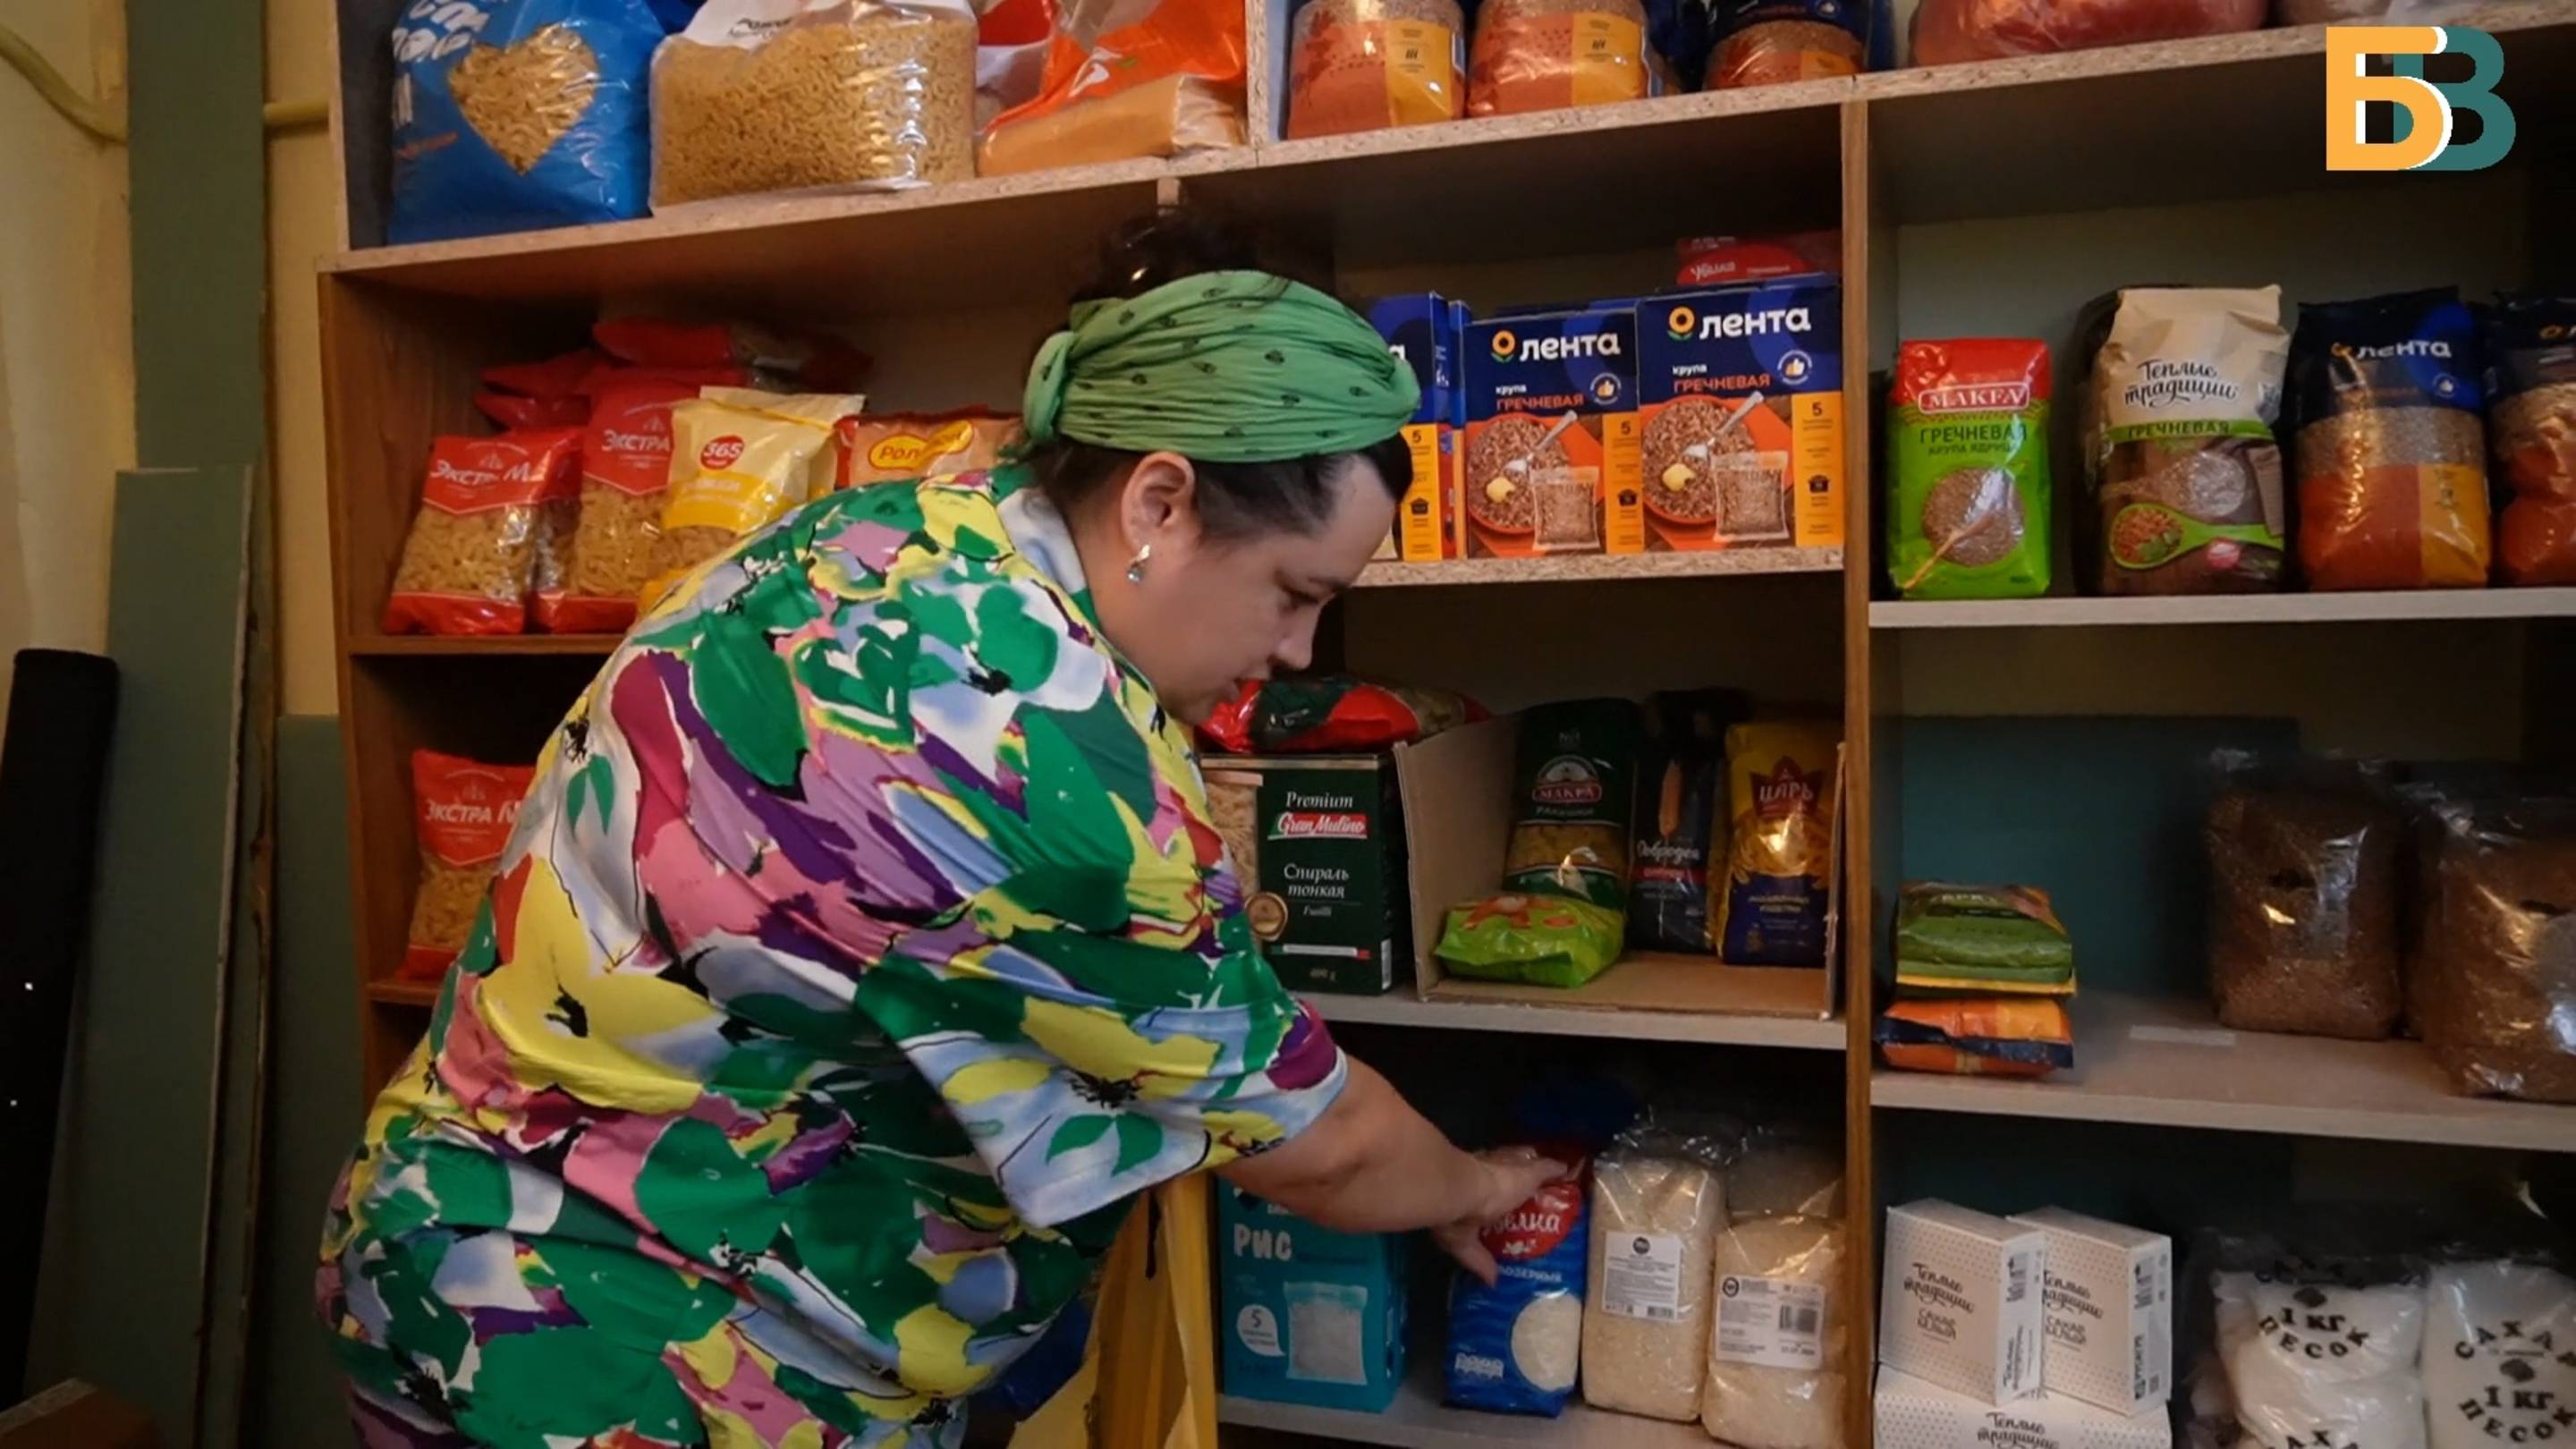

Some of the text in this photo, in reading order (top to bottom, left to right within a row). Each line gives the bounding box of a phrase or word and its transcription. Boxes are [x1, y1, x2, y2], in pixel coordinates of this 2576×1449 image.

[1699, 307, 1812, 341] лента
[1519, 333, 1622, 362] лента
[2357, 340, 2453, 359] лента
[1673, 364, 1708, 377] крупа
[1496, 385, 1528, 396] крупа
[1674, 373, 1771, 394] ГРЕЧНЕВАЯ
[1496, 394, 1585, 411] ГРЕЧНЕВАЯ
[1811, 402, 1823, 417] 5
[1411, 429, 1422, 444] 5
[1621, 420, 1631, 436] 5
[2127, 421, 2231, 438] ГРЕЧНЕВАЯ
[703, 442, 742, 458] 365
[1285, 791, 1353, 809] Premium
[1277, 811, 1366, 835] Gran Mulino
[1284, 863, 1350, 884] Спираль
[1288, 884, 1345, 899] тонкая
[1233, 1223, 1292, 1262] РИС
[2258, 1315, 2370, 1360] ПЕСОК
